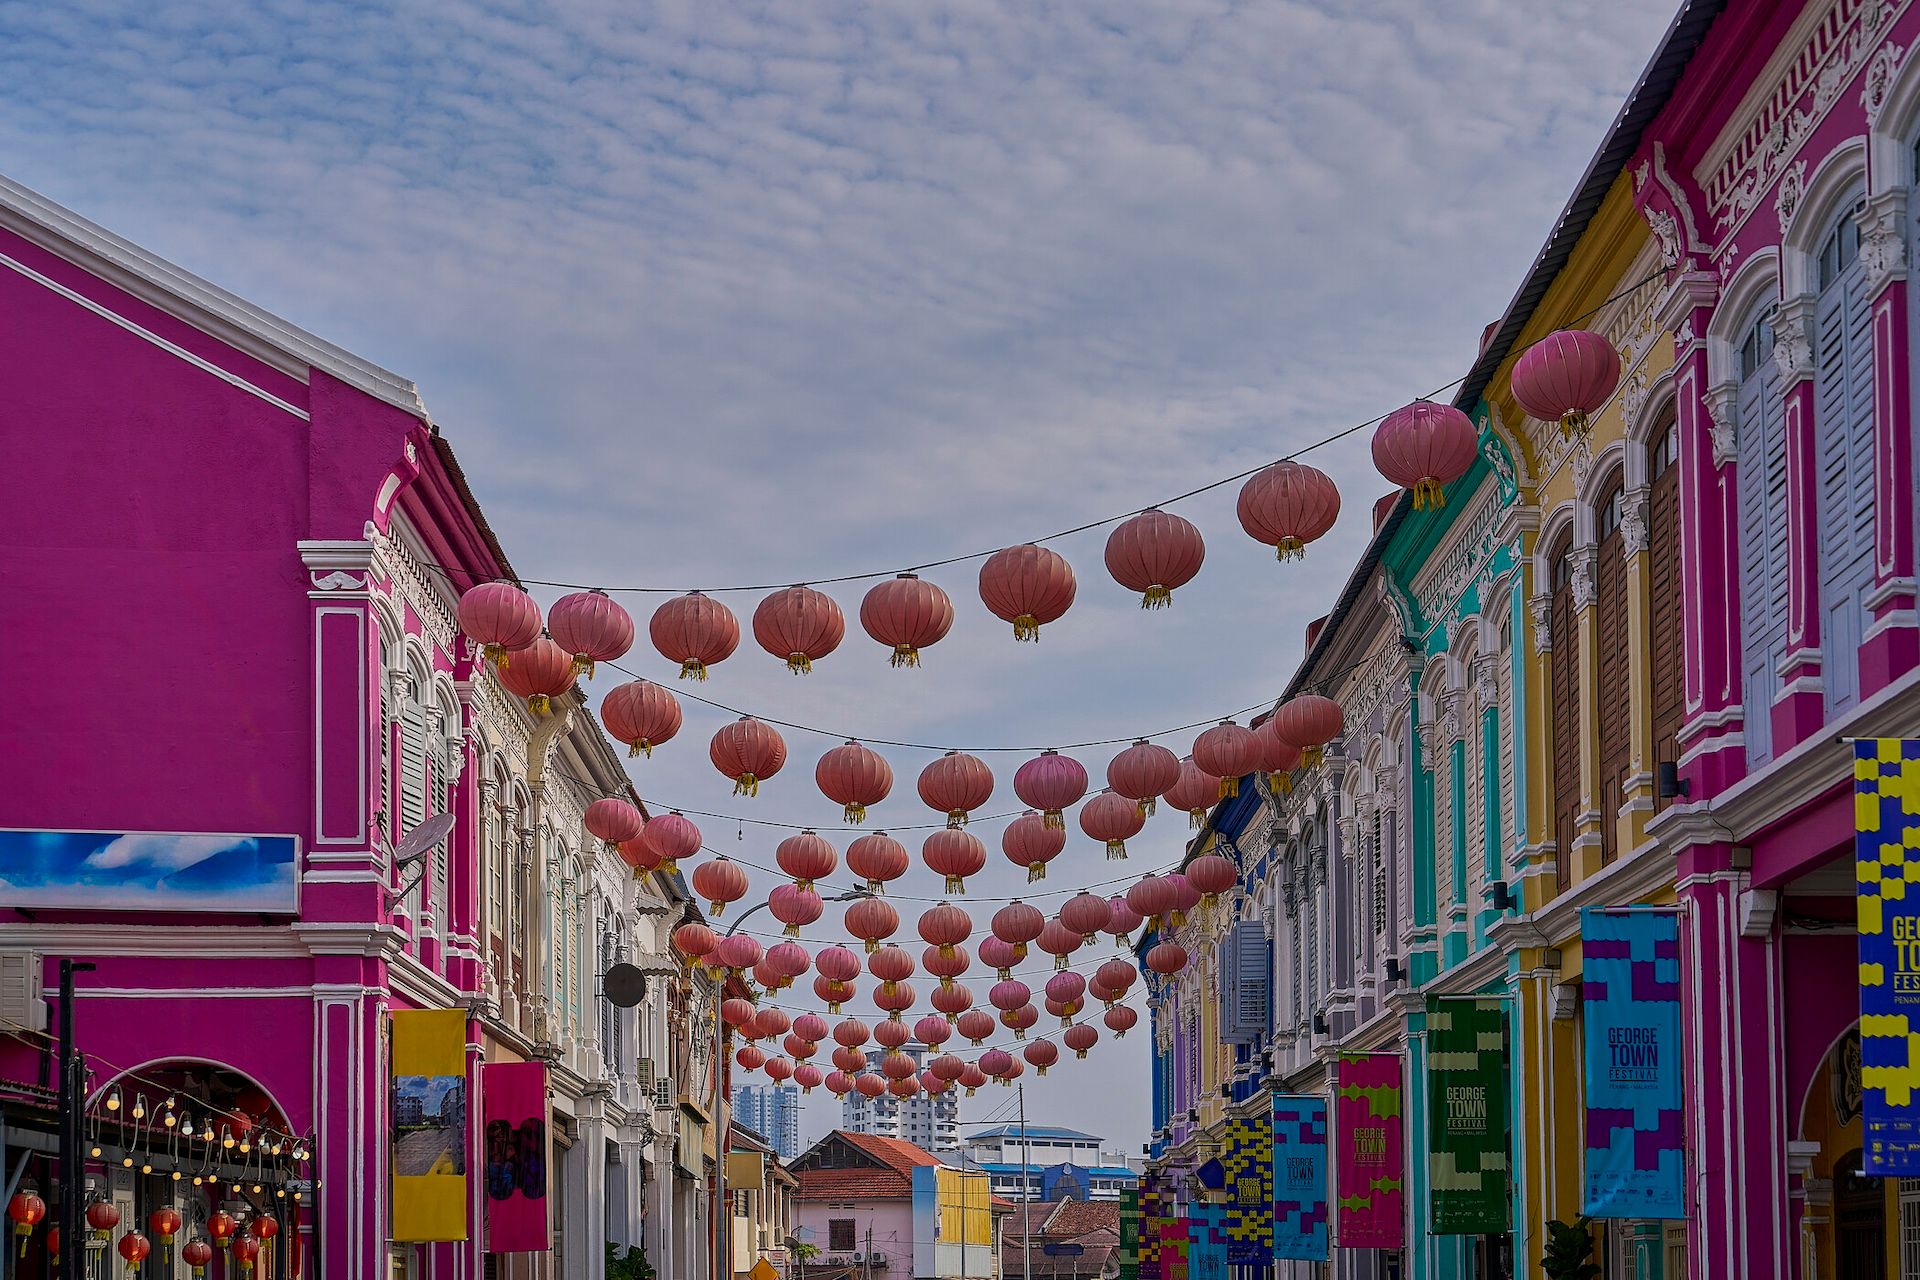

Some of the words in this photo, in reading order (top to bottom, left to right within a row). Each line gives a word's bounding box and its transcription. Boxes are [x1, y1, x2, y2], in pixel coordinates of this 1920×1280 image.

[1608, 1027, 1657, 1044] GEORGE
[1608, 1044, 1658, 1067] TOWN
[1609, 1069, 1658, 1079] FESTIVAL
[1446, 1086, 1486, 1100] GEORGE
[1446, 1100, 1487, 1117] TOWN
[1447, 1119, 1487, 1128] FESTIVAL
[1354, 1127, 1386, 1139] GEORGE
[1354, 1138, 1386, 1153] TOWN
[1286, 1157, 1313, 1167] GEORGE
[1286, 1166, 1314, 1179] TOWN
[1237, 1186, 1261, 1197] TOWN
